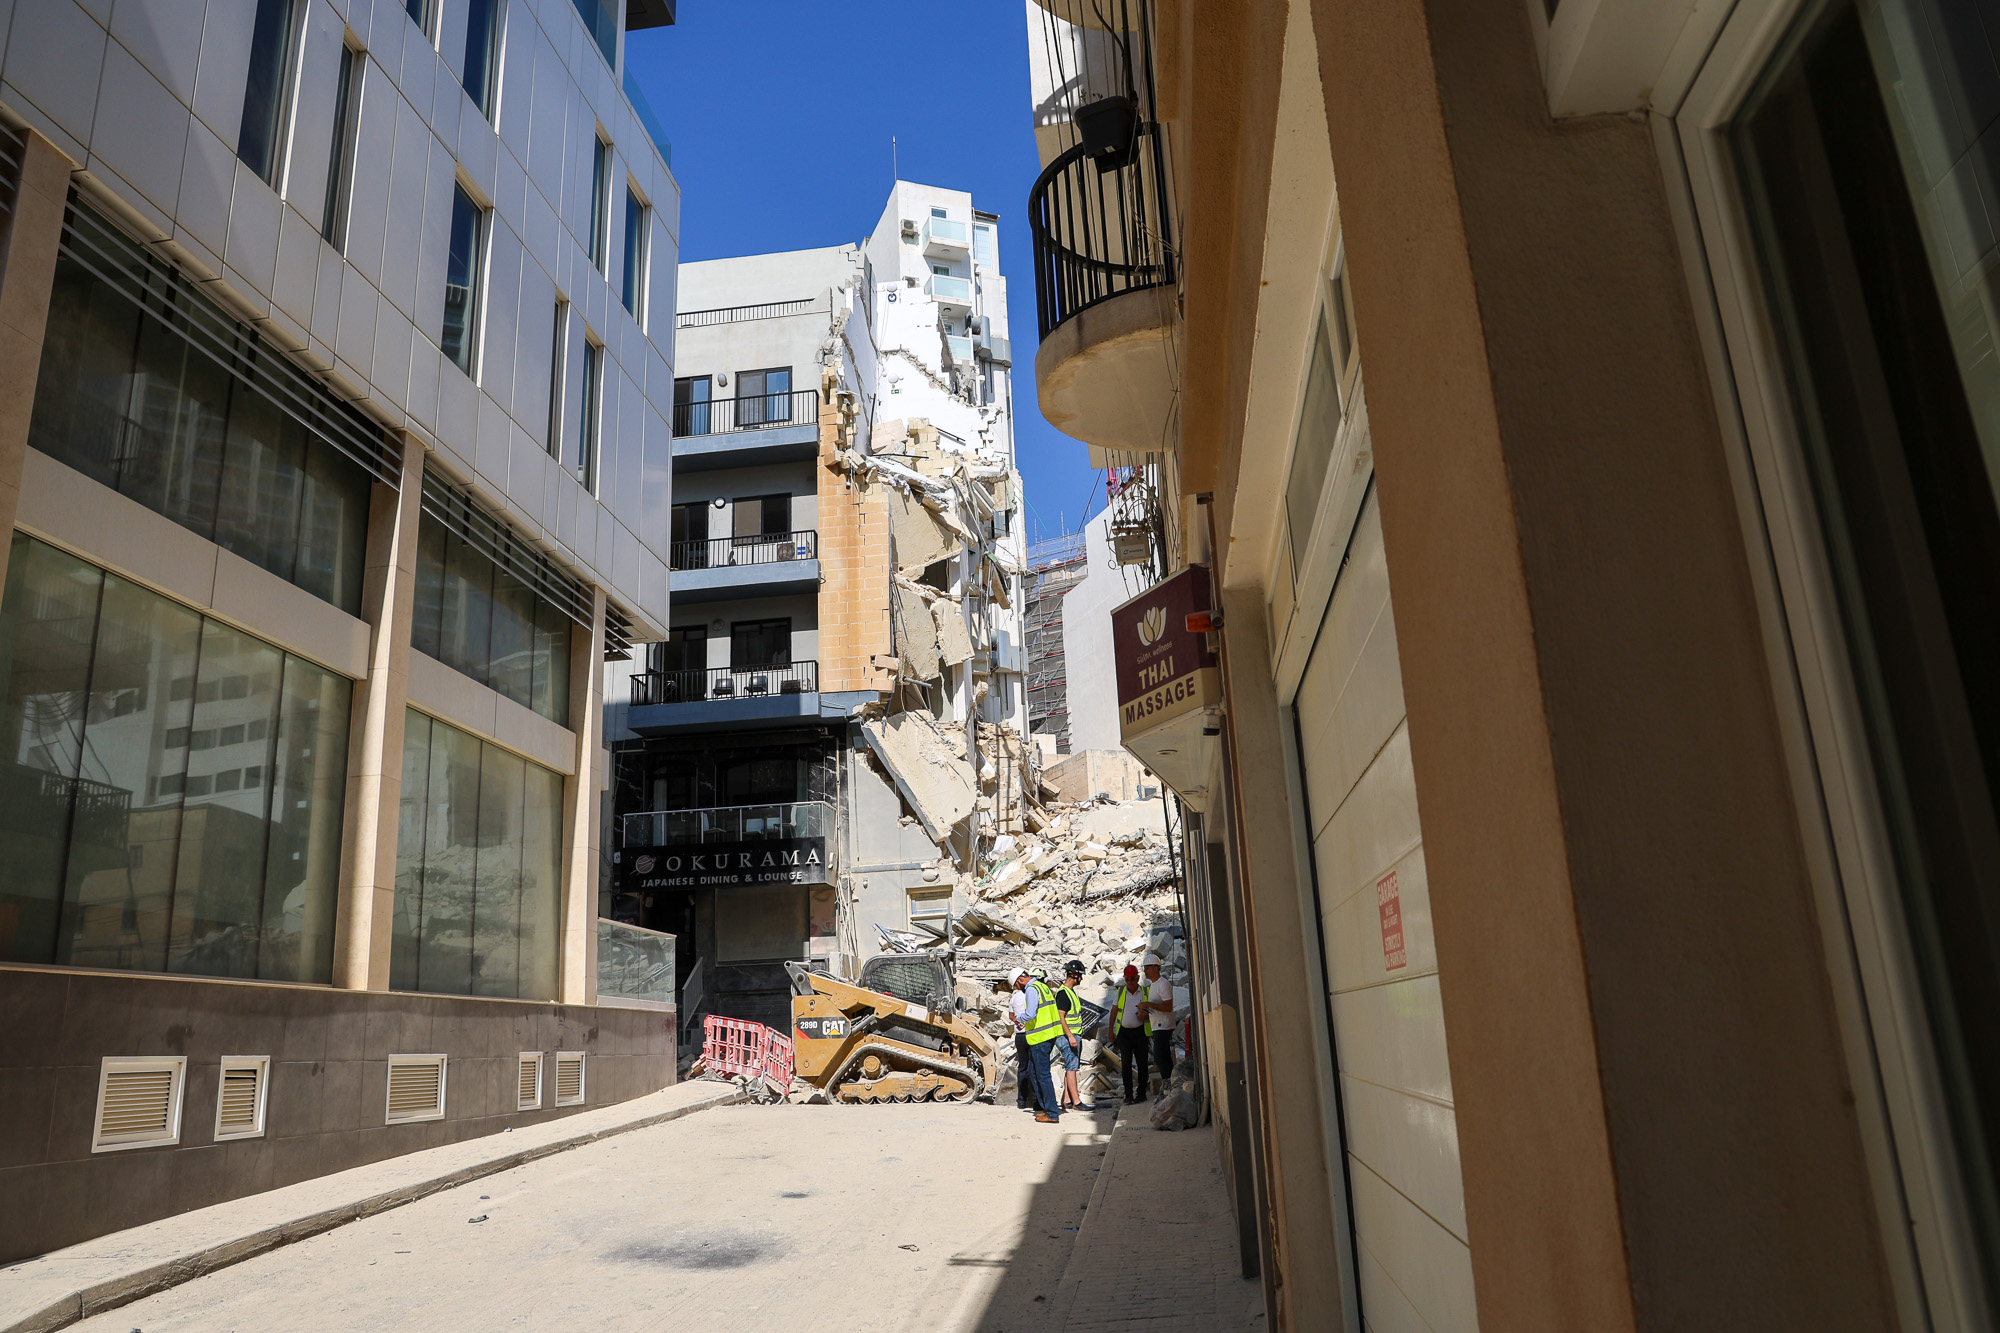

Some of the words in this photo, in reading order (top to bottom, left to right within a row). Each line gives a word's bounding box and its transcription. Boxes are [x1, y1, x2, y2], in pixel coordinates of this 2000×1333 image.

[1138, 655, 1175, 690] THAI
[1125, 676, 1196, 725] MASSAGE
[666, 848, 822, 872] OKURAMA
[641, 877, 695, 888] JAPANESE
[700, 874, 739, 884] DINING
[745, 873, 753, 882] &
[758, 871, 803, 882] LOUNGE
[1377, 875, 1399, 907] GARAGE
[800, 1021, 818, 1029] 289D
[822, 1020, 845, 1035] CAT
